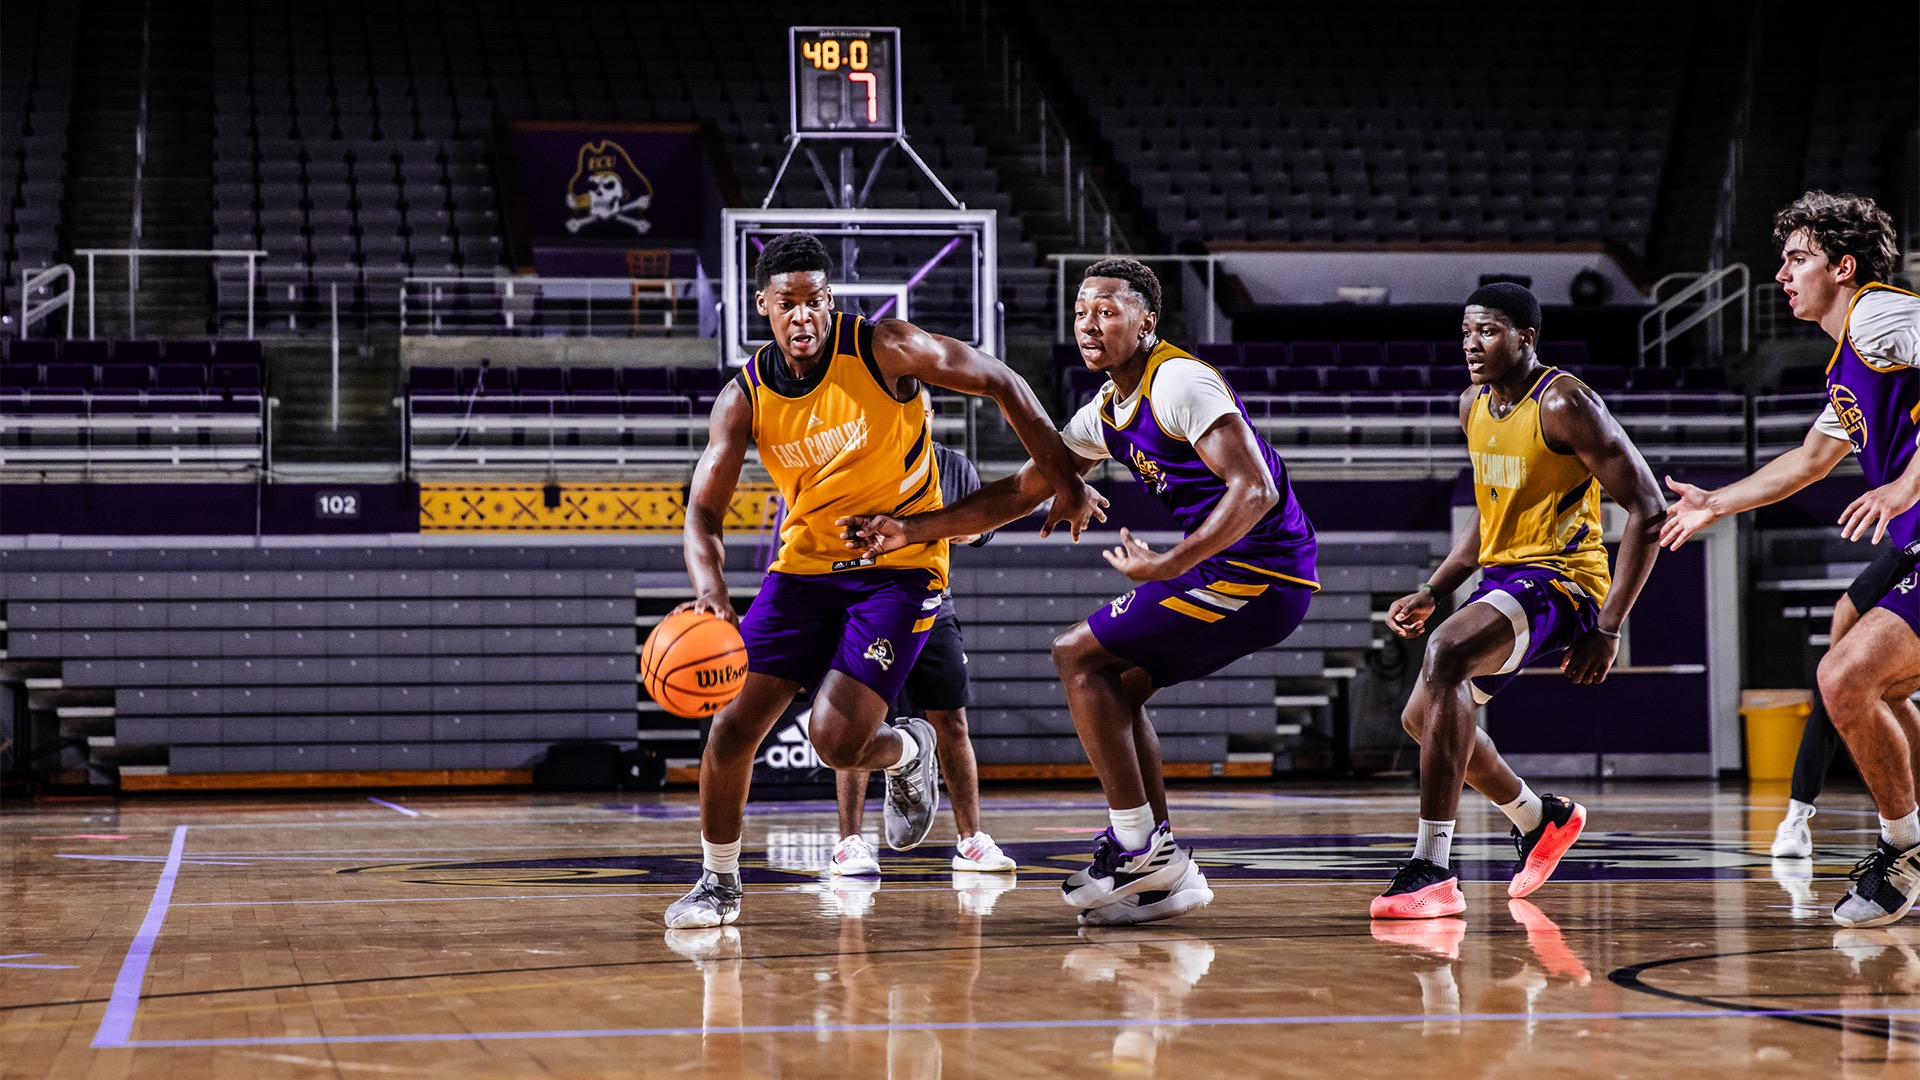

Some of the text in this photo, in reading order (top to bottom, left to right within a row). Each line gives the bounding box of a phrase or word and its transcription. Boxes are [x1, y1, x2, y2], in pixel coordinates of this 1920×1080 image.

[802, 40, 868, 70] 48.0
[848, 72, 877, 122] 7
[771, 440, 810, 469] EAST
[320, 495, 356, 514] 102
